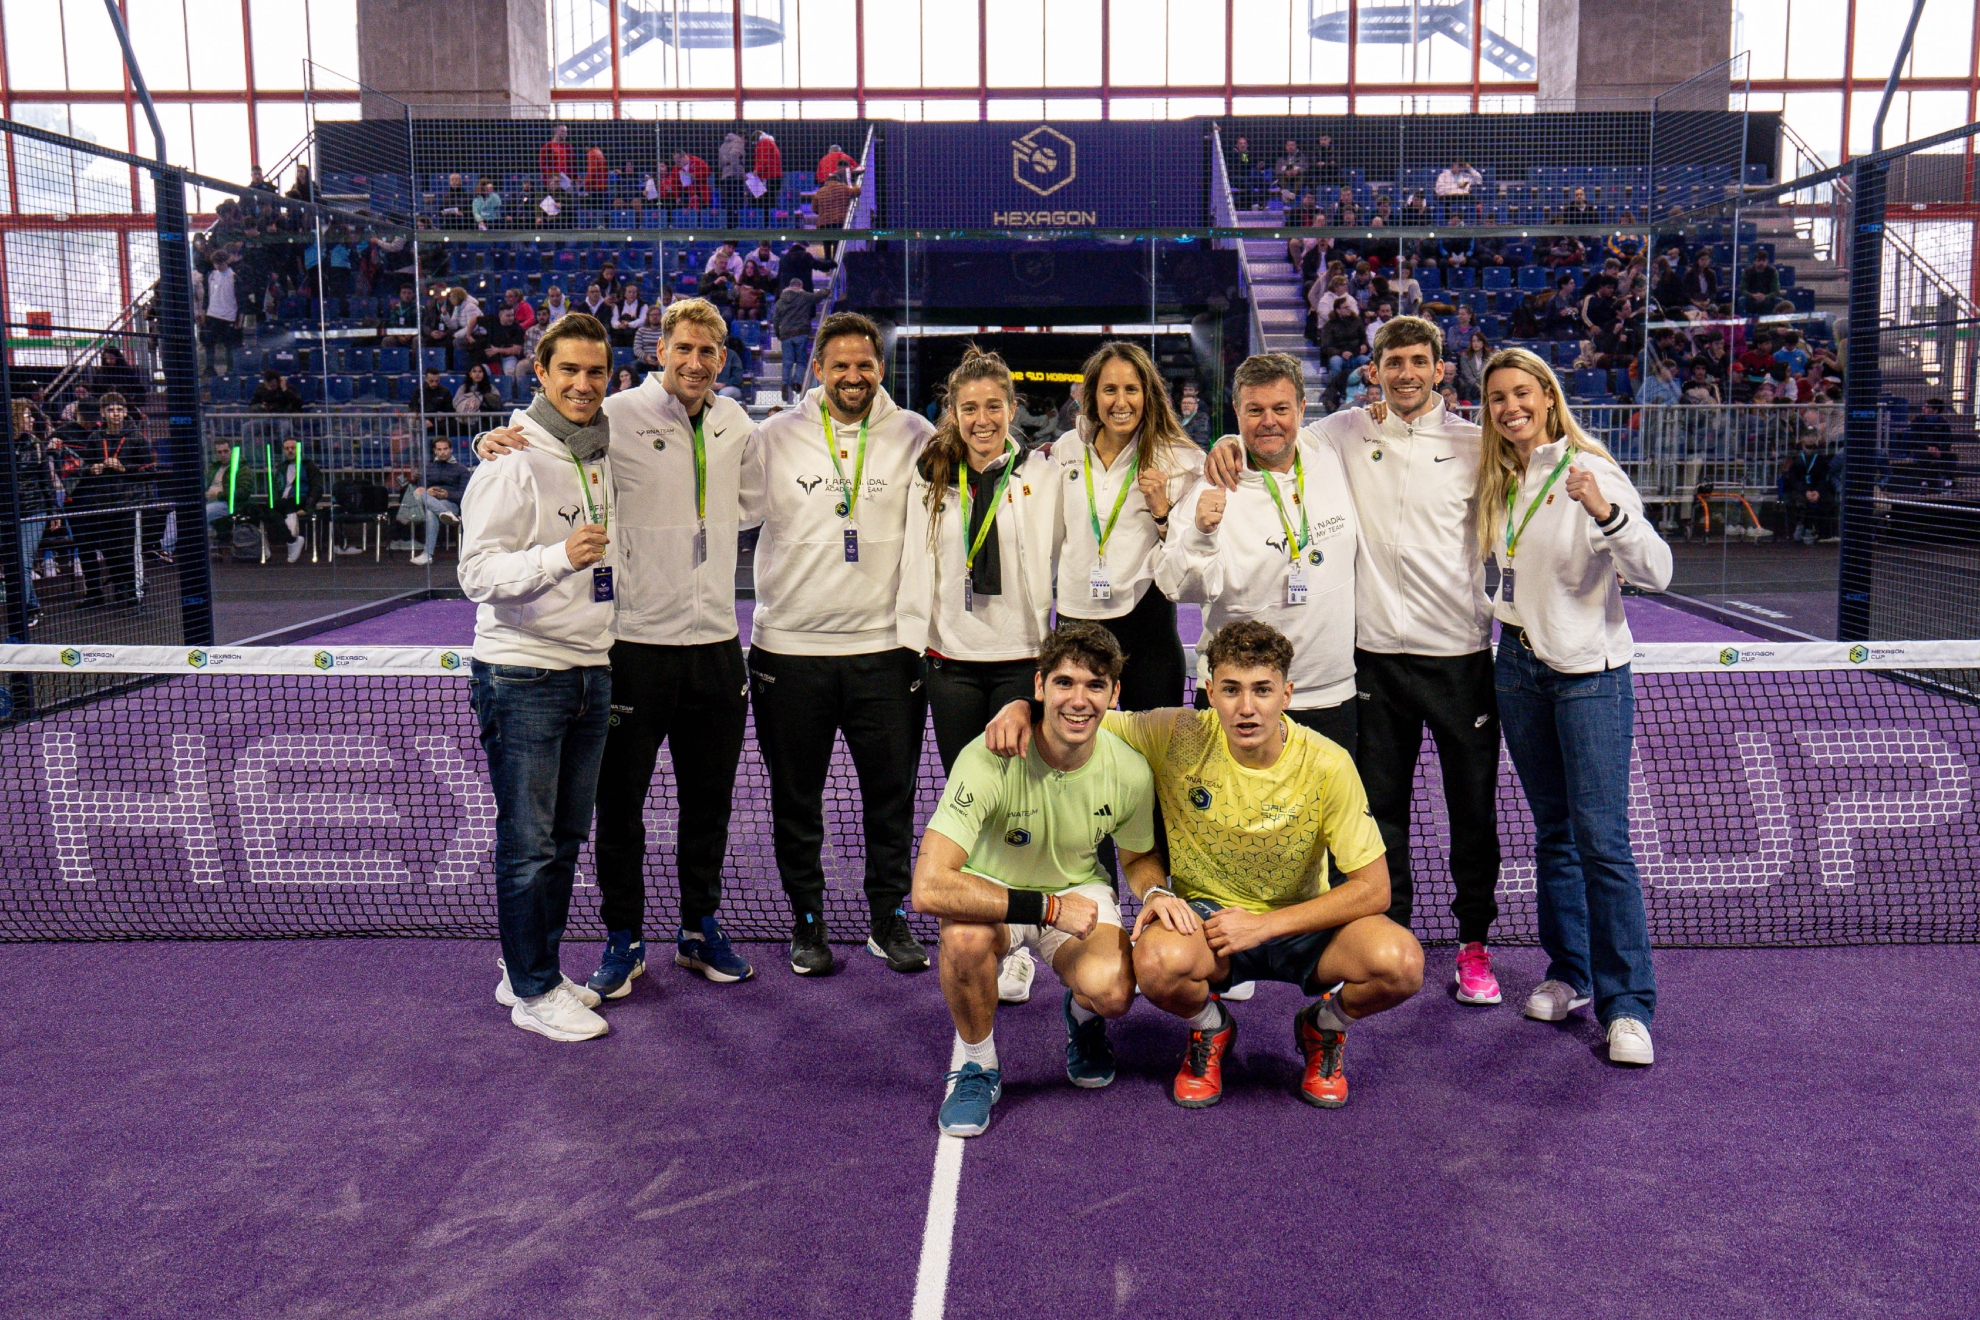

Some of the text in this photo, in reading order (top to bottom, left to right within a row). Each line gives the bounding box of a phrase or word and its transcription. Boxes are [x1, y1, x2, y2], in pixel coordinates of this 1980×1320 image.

[993, 211, 1096, 226] HEXAGON
[1317, 514, 1346, 530] NADAL
[1328, 523, 1345, 534] TEAM
[1184, 774, 1224, 790] RNA TEAM
